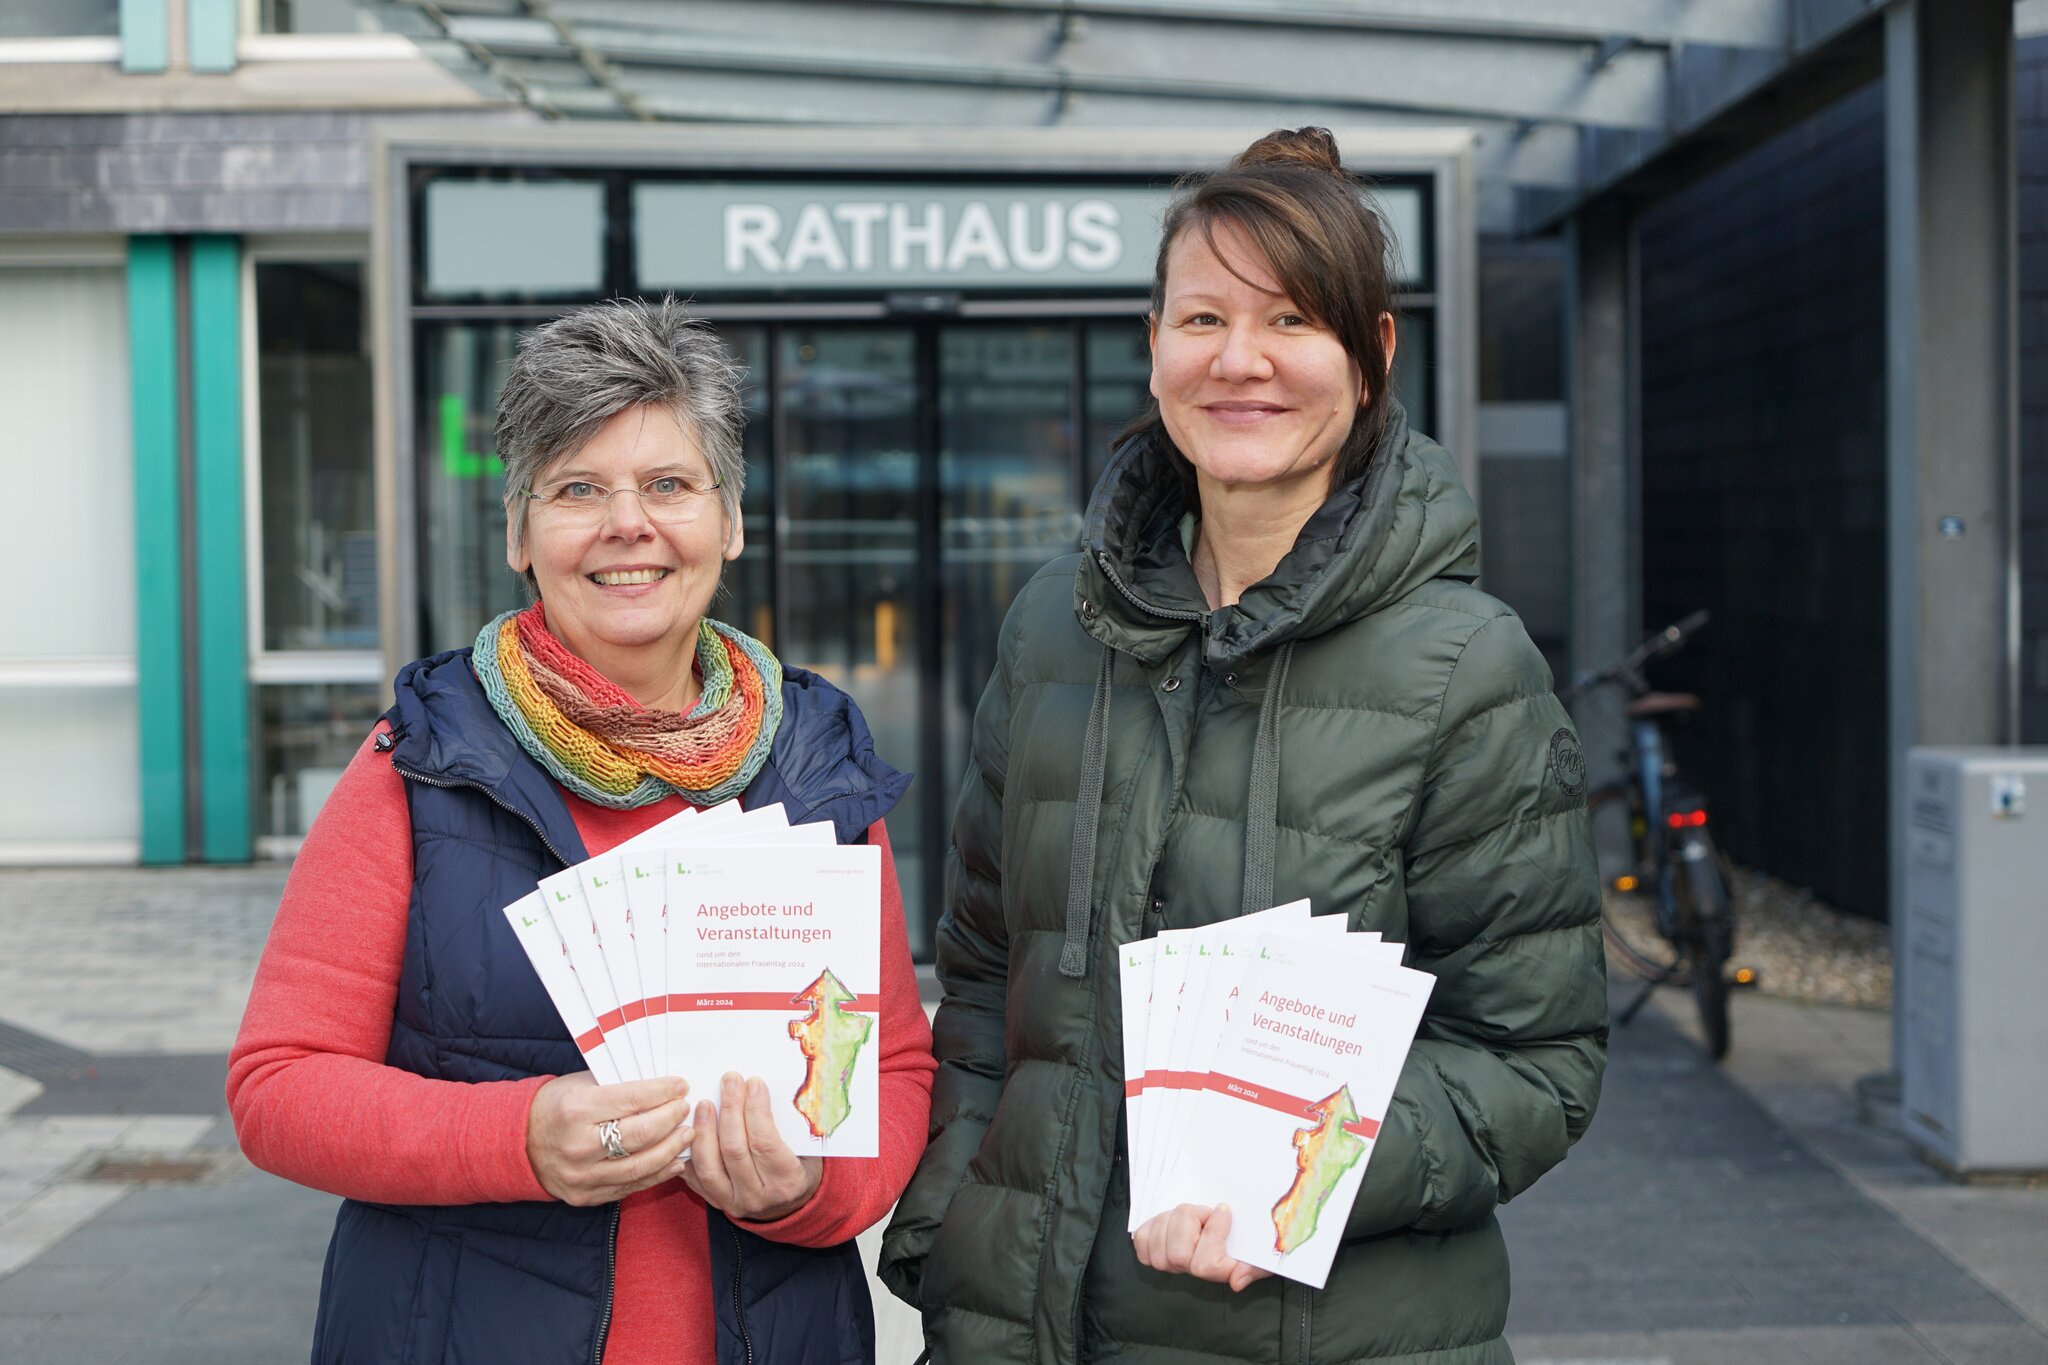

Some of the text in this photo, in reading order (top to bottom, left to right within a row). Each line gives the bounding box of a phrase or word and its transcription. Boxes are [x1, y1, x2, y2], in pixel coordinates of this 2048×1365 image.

[724, 201, 1122, 273] RATHAUS
[697, 902, 813, 920] Angebote und
[697, 926, 831, 943] Veranstaltungen
[696, 998, 714, 1006] März
[1259, 991, 1325, 1020] Angebote
[1329, 1012, 1357, 1028] und
[1244, 1037, 1258, 1046] rund
[1252, 1013, 1363, 1056] Veranstaltungen
[1227, 1083, 1259, 1100] März 2024
